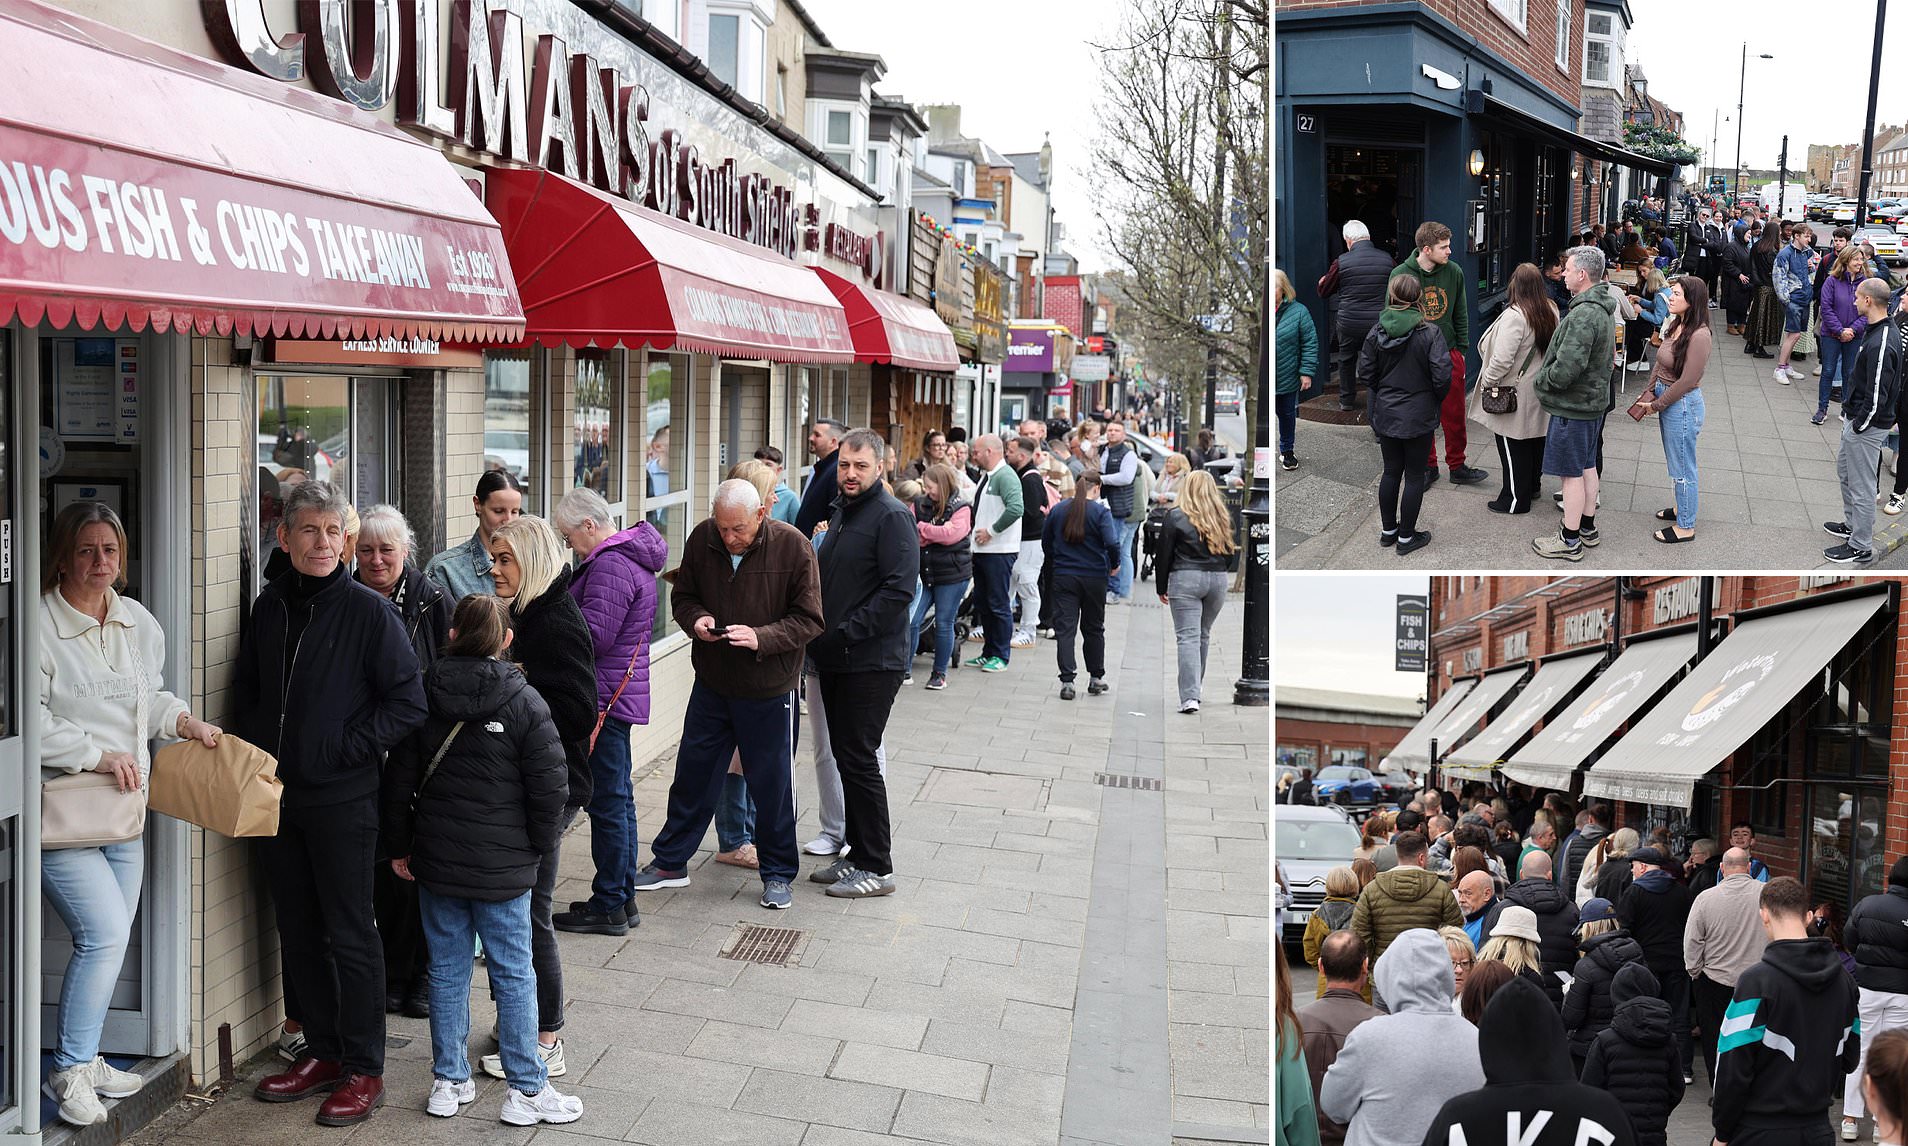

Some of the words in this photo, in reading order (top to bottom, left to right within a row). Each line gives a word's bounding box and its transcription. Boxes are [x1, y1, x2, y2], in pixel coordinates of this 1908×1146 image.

[1300, 116, 1314, 131] 27
[655, 129, 682, 217] of
[687, 144, 742, 239] South
[745, 172, 800, 261] Shields
[81, 174, 182, 262] FISH
[180, 197, 218, 265] &
[216, 199, 310, 277] CHIPS
[305, 217, 431, 289] TAKEAWAY
[446, 245, 469, 277] Est
[466, 250, 495, 280] 1926
[342, 339, 378, 352] EXPRESS
[378, 336, 409, 354] SERVICE
[410, 335, 440, 355] COUNTER
[1400, 615, 1423, 627] FISH
[1407, 627, 1416, 639] &
[1397, 639, 1425, 651] CHIPS
